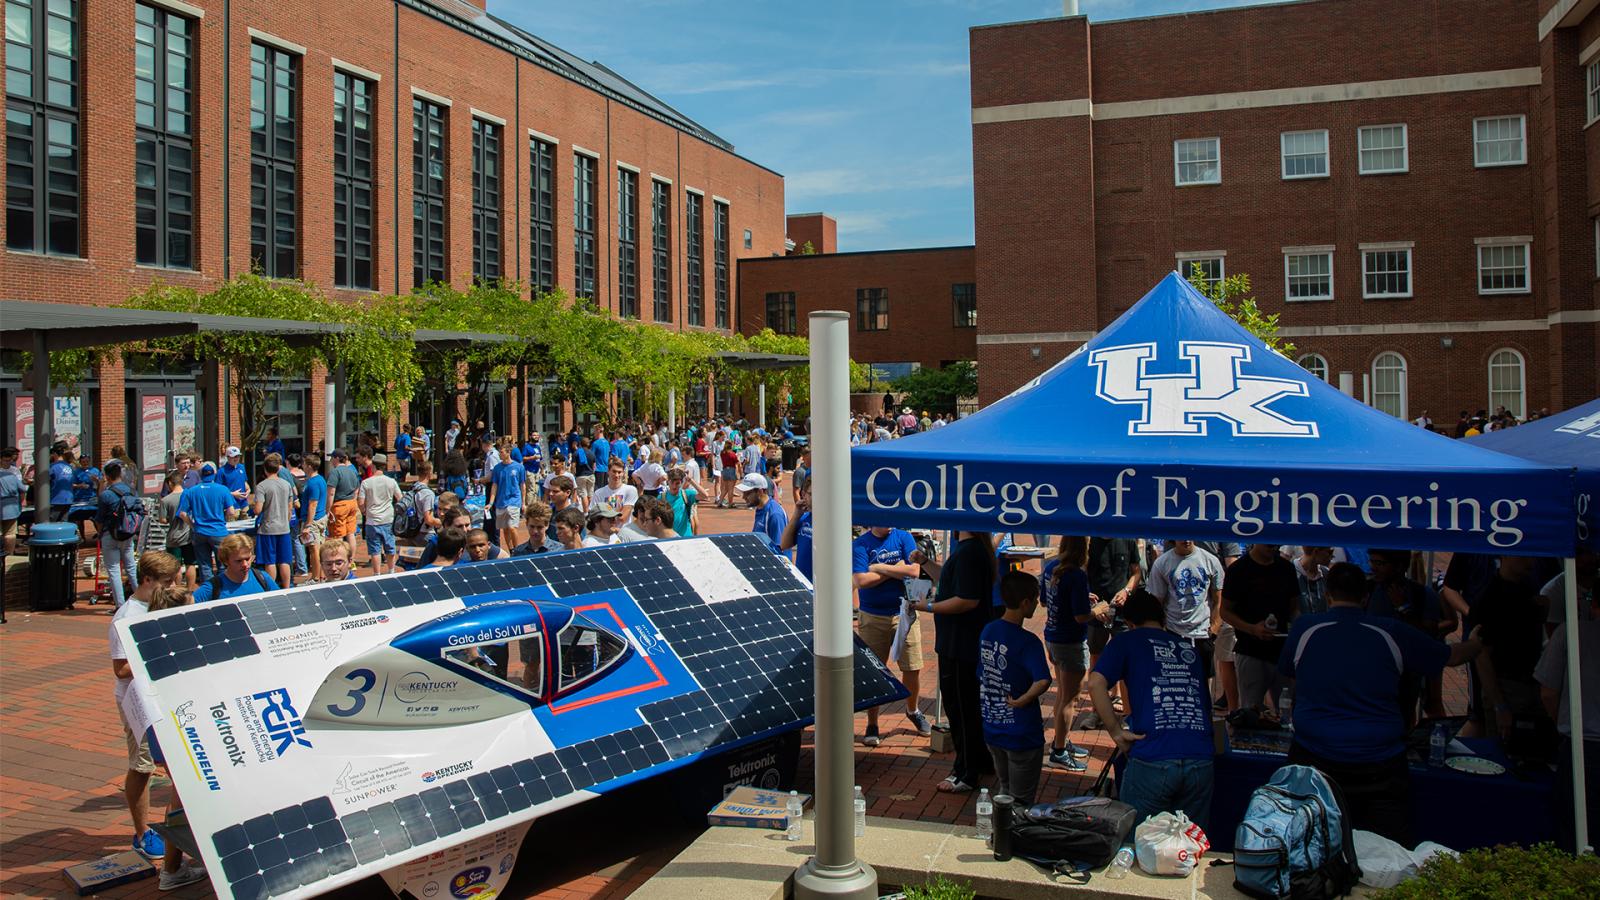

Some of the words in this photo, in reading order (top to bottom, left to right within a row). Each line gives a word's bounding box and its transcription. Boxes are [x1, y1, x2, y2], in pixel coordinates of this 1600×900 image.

[1088, 341, 1319, 438] UK
[175, 397, 192, 414] UK
[56, 418, 79, 427] Dining
[866, 463, 1060, 526] College
[1076, 468, 1136, 518] of
[1152, 475, 1528, 548] Engineering
[341, 620, 378, 631] KENTUCKY
[448, 635, 475, 646] Gato
[477, 628, 493, 641] del
[495, 625, 510, 638] Sol
[511, 624, 521, 635] VI
[268, 630, 319, 645] SUNPOWER
[1161, 662, 1190, 670] Tektronix
[327, 668, 377, 717] 3
[409, 681, 458, 690] KENTUCKY
[235, 697, 250, 723] Institute
[210, 701, 245, 768] Tektronix
[243, 695, 258, 722] Power
[253, 719, 265, 734] and
[259, 733, 275, 761] Energy
[247, 722, 255, 732] of
[250, 732, 267, 763] Kentucky
[185, 726, 221, 791] MICHELIN
[435, 759, 473, 776] KENTUCKY
[728, 752, 776, 779] Tektronix
[351, 777, 368, 786] Circuit
[385, 766, 409, 777] Americas
[436, 765, 474, 780] SPEEDWAY
[344, 784, 396, 805] SUNPOWER
[431, 851, 445, 860] 3M
